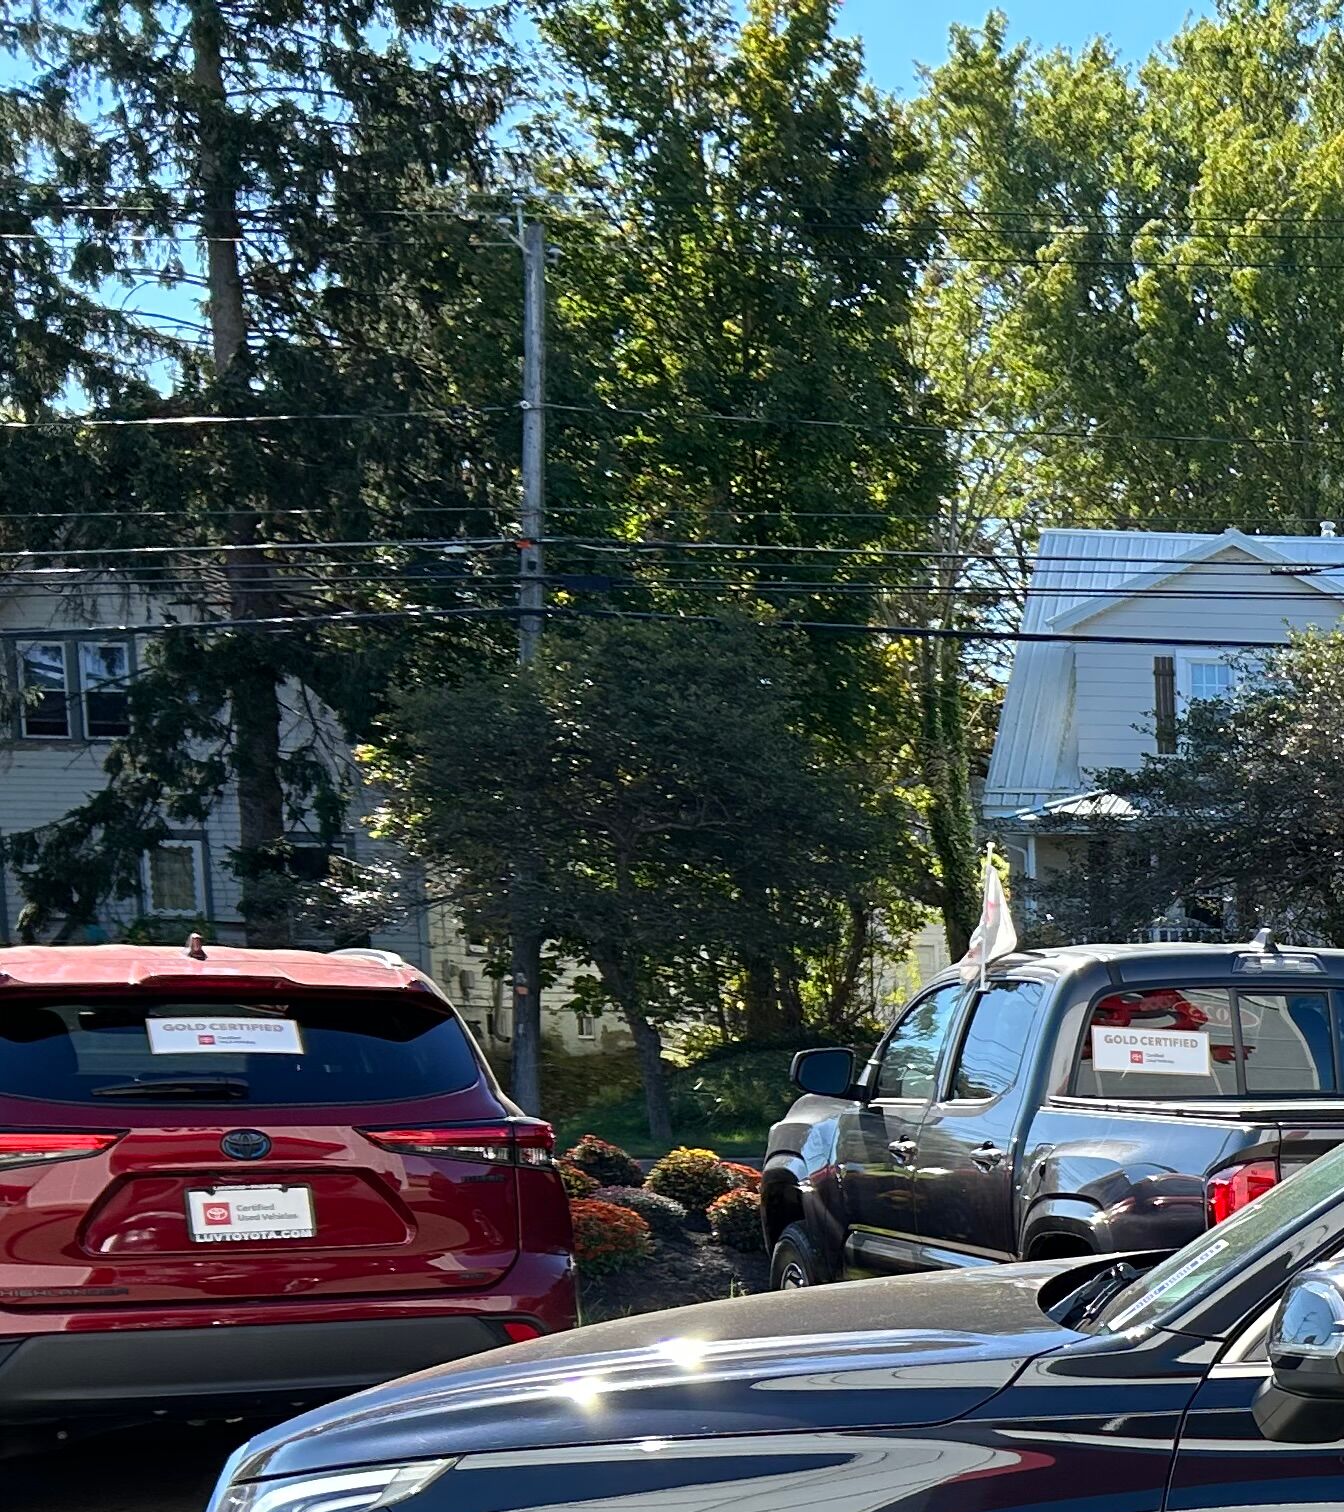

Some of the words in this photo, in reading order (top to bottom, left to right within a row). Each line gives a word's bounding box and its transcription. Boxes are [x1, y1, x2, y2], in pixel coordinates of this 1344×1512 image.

[162, 1023, 206, 1032] GOLD
[209, 1023, 284, 1032] CERTIFIED
[1104, 1034, 1138, 1045] GOLD
[1140, 1036, 1199, 1049] CERTIFIED
[236, 1204, 275, 1212] Certified
[262, 1213, 298, 1221] Vehicles
[195, 1229, 313, 1242] LUVTOYOTA.COM
